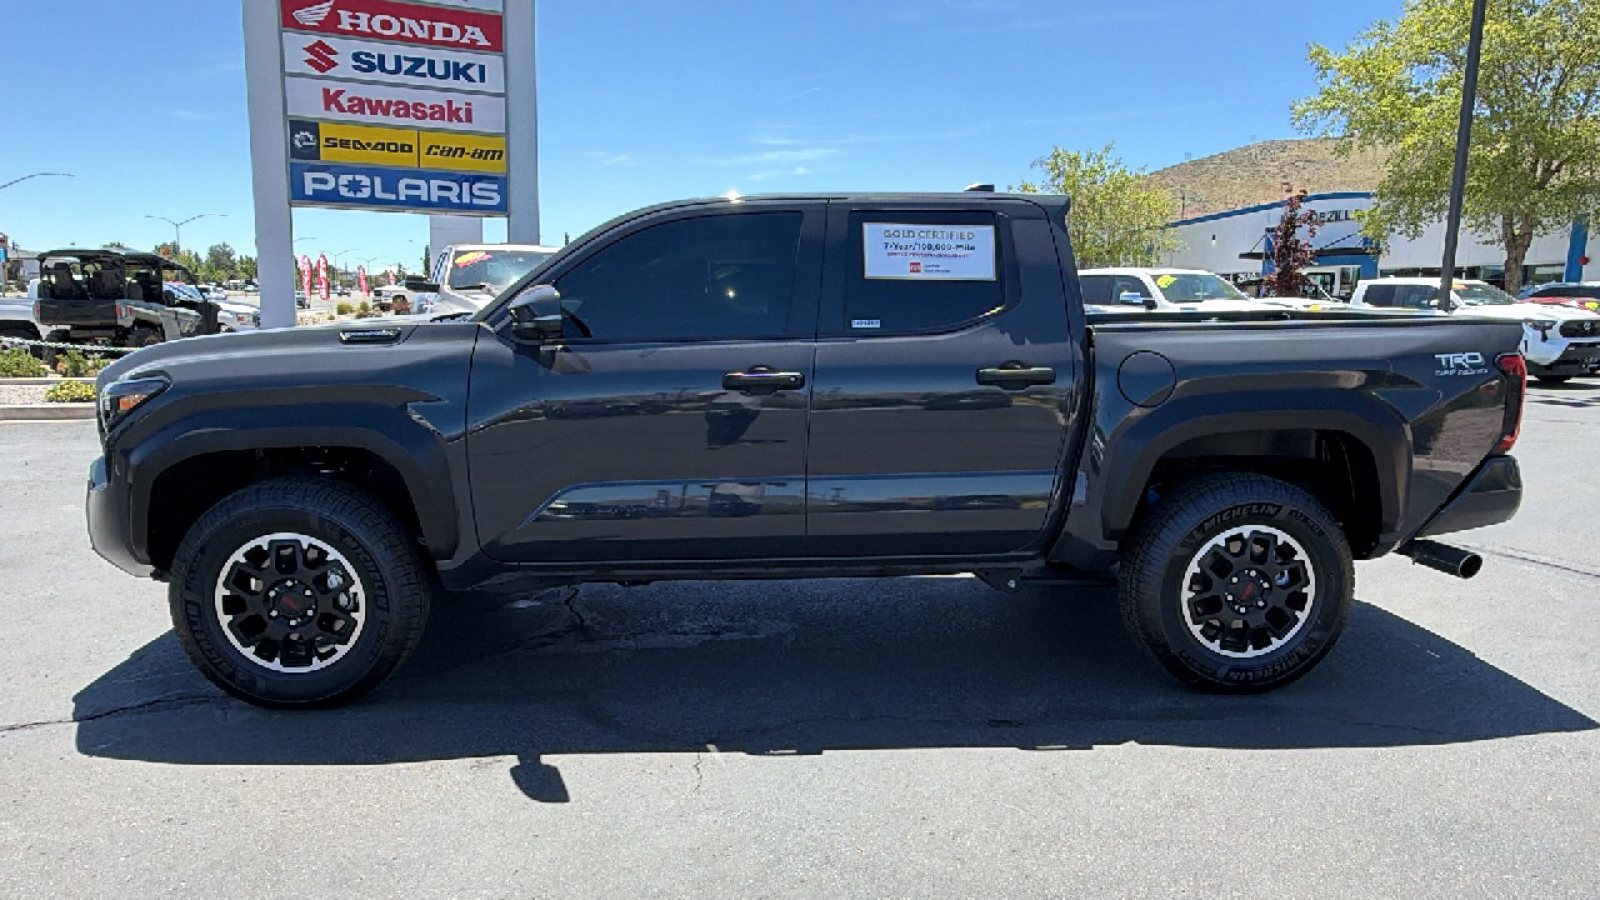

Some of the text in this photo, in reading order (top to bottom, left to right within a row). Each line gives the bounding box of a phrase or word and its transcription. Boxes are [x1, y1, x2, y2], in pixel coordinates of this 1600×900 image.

[337, 9, 492, 47] HONDA
[351, 51, 486, 83] SUZUKI
[322, 87, 474, 124] Kawasaki
[303, 171, 501, 206] POLARIS
[884, 229, 976, 241] GOLD CERTIFIED
[1434, 352, 1485, 369] TRD
[1203, 504, 1279, 531] MICHELIN
